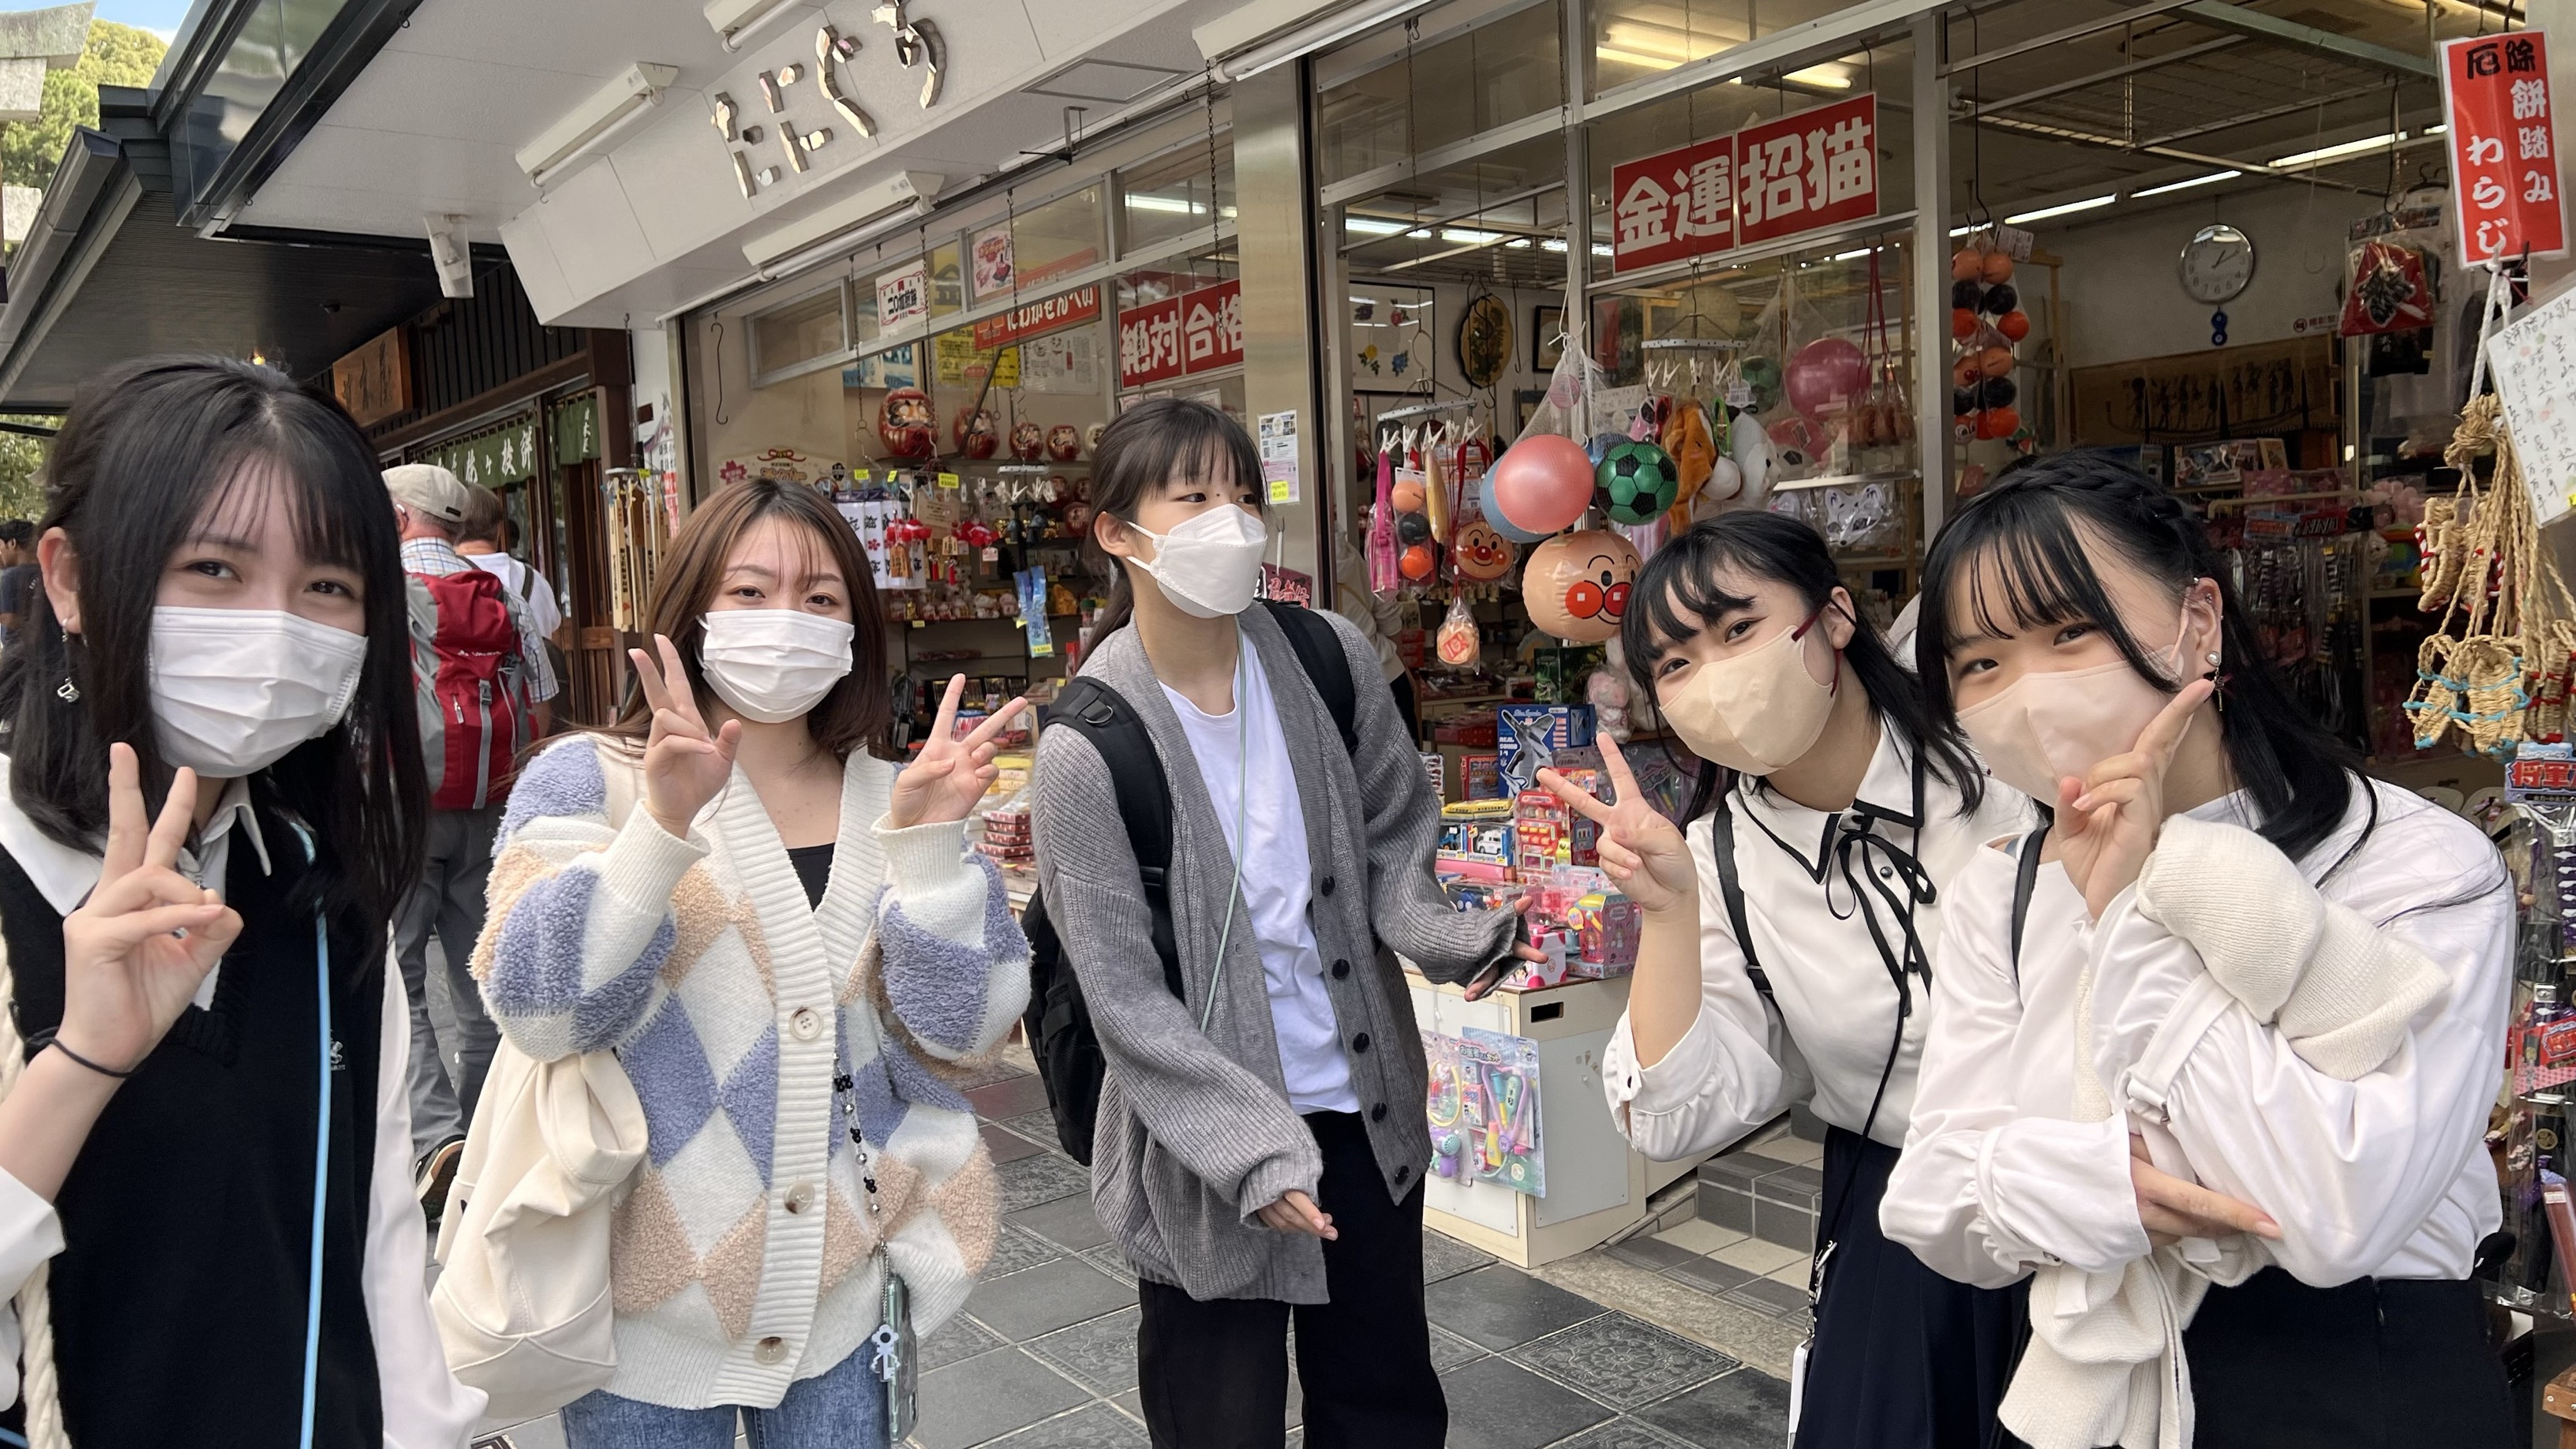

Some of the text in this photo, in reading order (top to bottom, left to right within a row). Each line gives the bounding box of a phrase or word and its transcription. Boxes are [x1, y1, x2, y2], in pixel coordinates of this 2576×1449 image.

[2466, 39, 2536, 79] 厄除
[1616, 116, 1873, 255] 金運招猫
[2466, 135, 2509, 253] わらじ
[2510, 79, 2553, 203] 餅踏み
